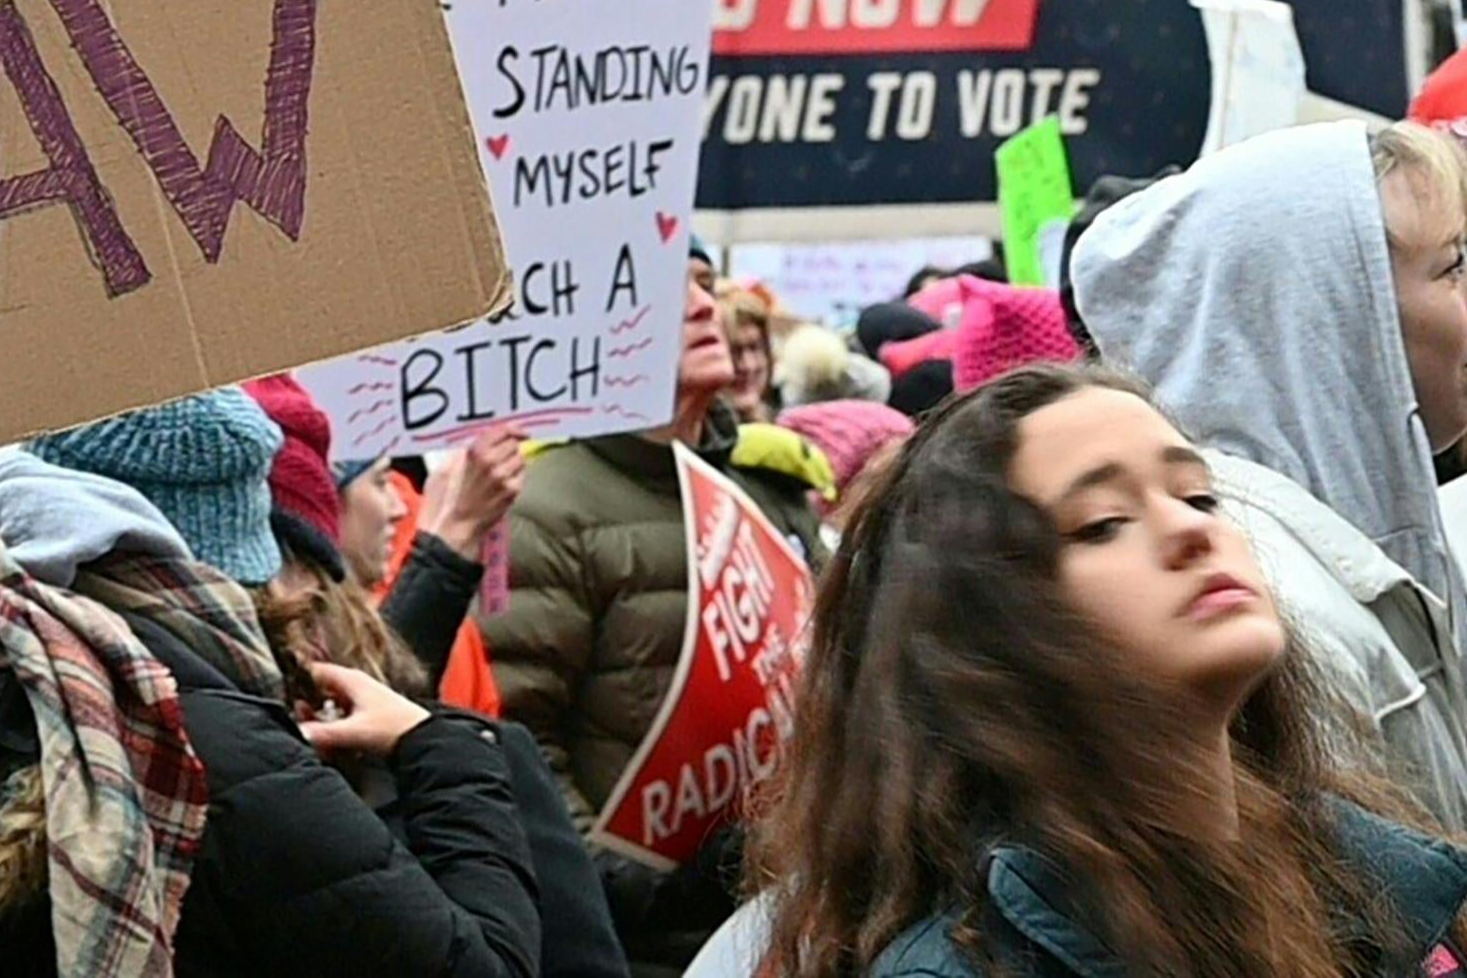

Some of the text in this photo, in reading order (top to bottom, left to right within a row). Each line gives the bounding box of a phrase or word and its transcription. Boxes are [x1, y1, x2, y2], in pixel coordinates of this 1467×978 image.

[491, 45, 701, 119] STANDING
[866, 70, 938, 142] TO
[957, 67, 1102, 139] VOTE
[513, 138, 675, 207] MYSELF
[604, 242, 638, 314] A
[400, 335, 603, 430] BITCH
